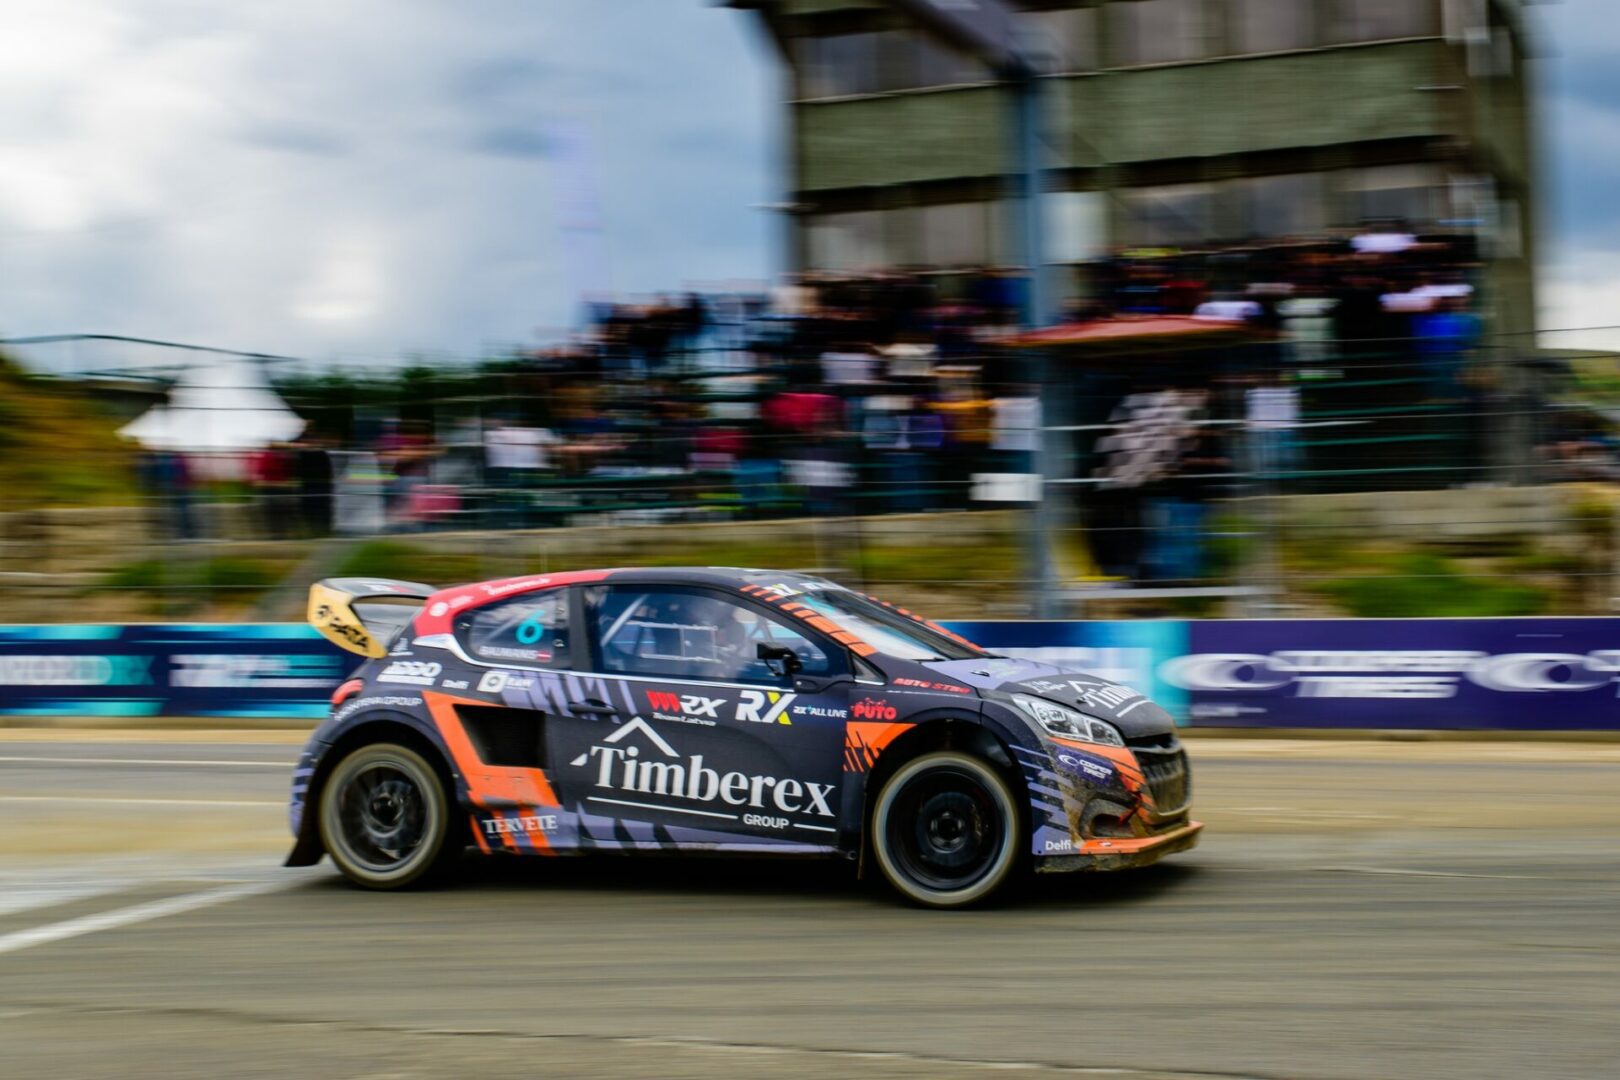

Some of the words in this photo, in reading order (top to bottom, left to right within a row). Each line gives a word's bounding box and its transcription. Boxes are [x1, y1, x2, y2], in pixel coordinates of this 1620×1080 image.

[515, 610, 545, 645] 6
[735, 690, 798, 725] RX
[853, 702, 897, 720] PUTO
[590, 746, 836, 817] Timberex
[743, 814, 789, 829] GROUP
[1045, 840, 1072, 851] Delfi
